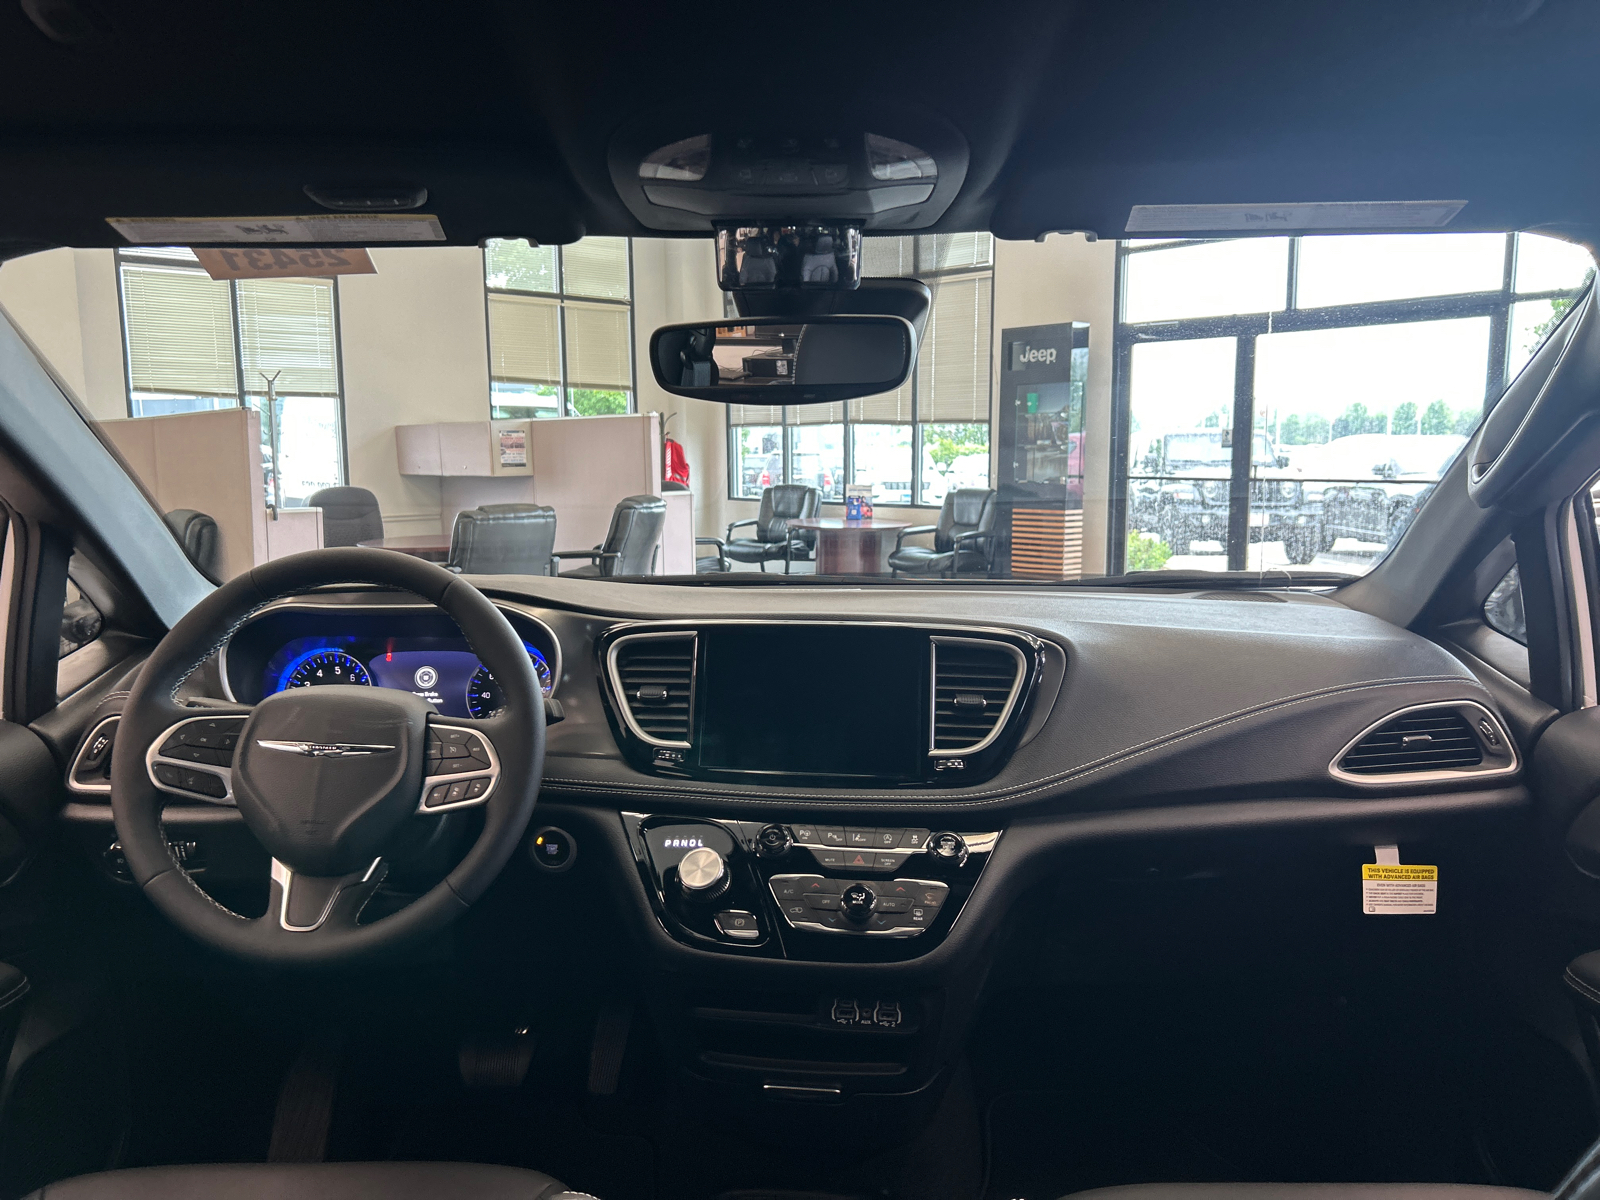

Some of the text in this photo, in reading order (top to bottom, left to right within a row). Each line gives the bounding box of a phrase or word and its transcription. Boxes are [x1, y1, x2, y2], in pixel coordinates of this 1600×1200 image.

[1020, 346, 1057, 364] Jeep
[316, 669, 323, 677] 4
[334, 666, 341, 674] 5
[350, 674, 356, 682] 6
